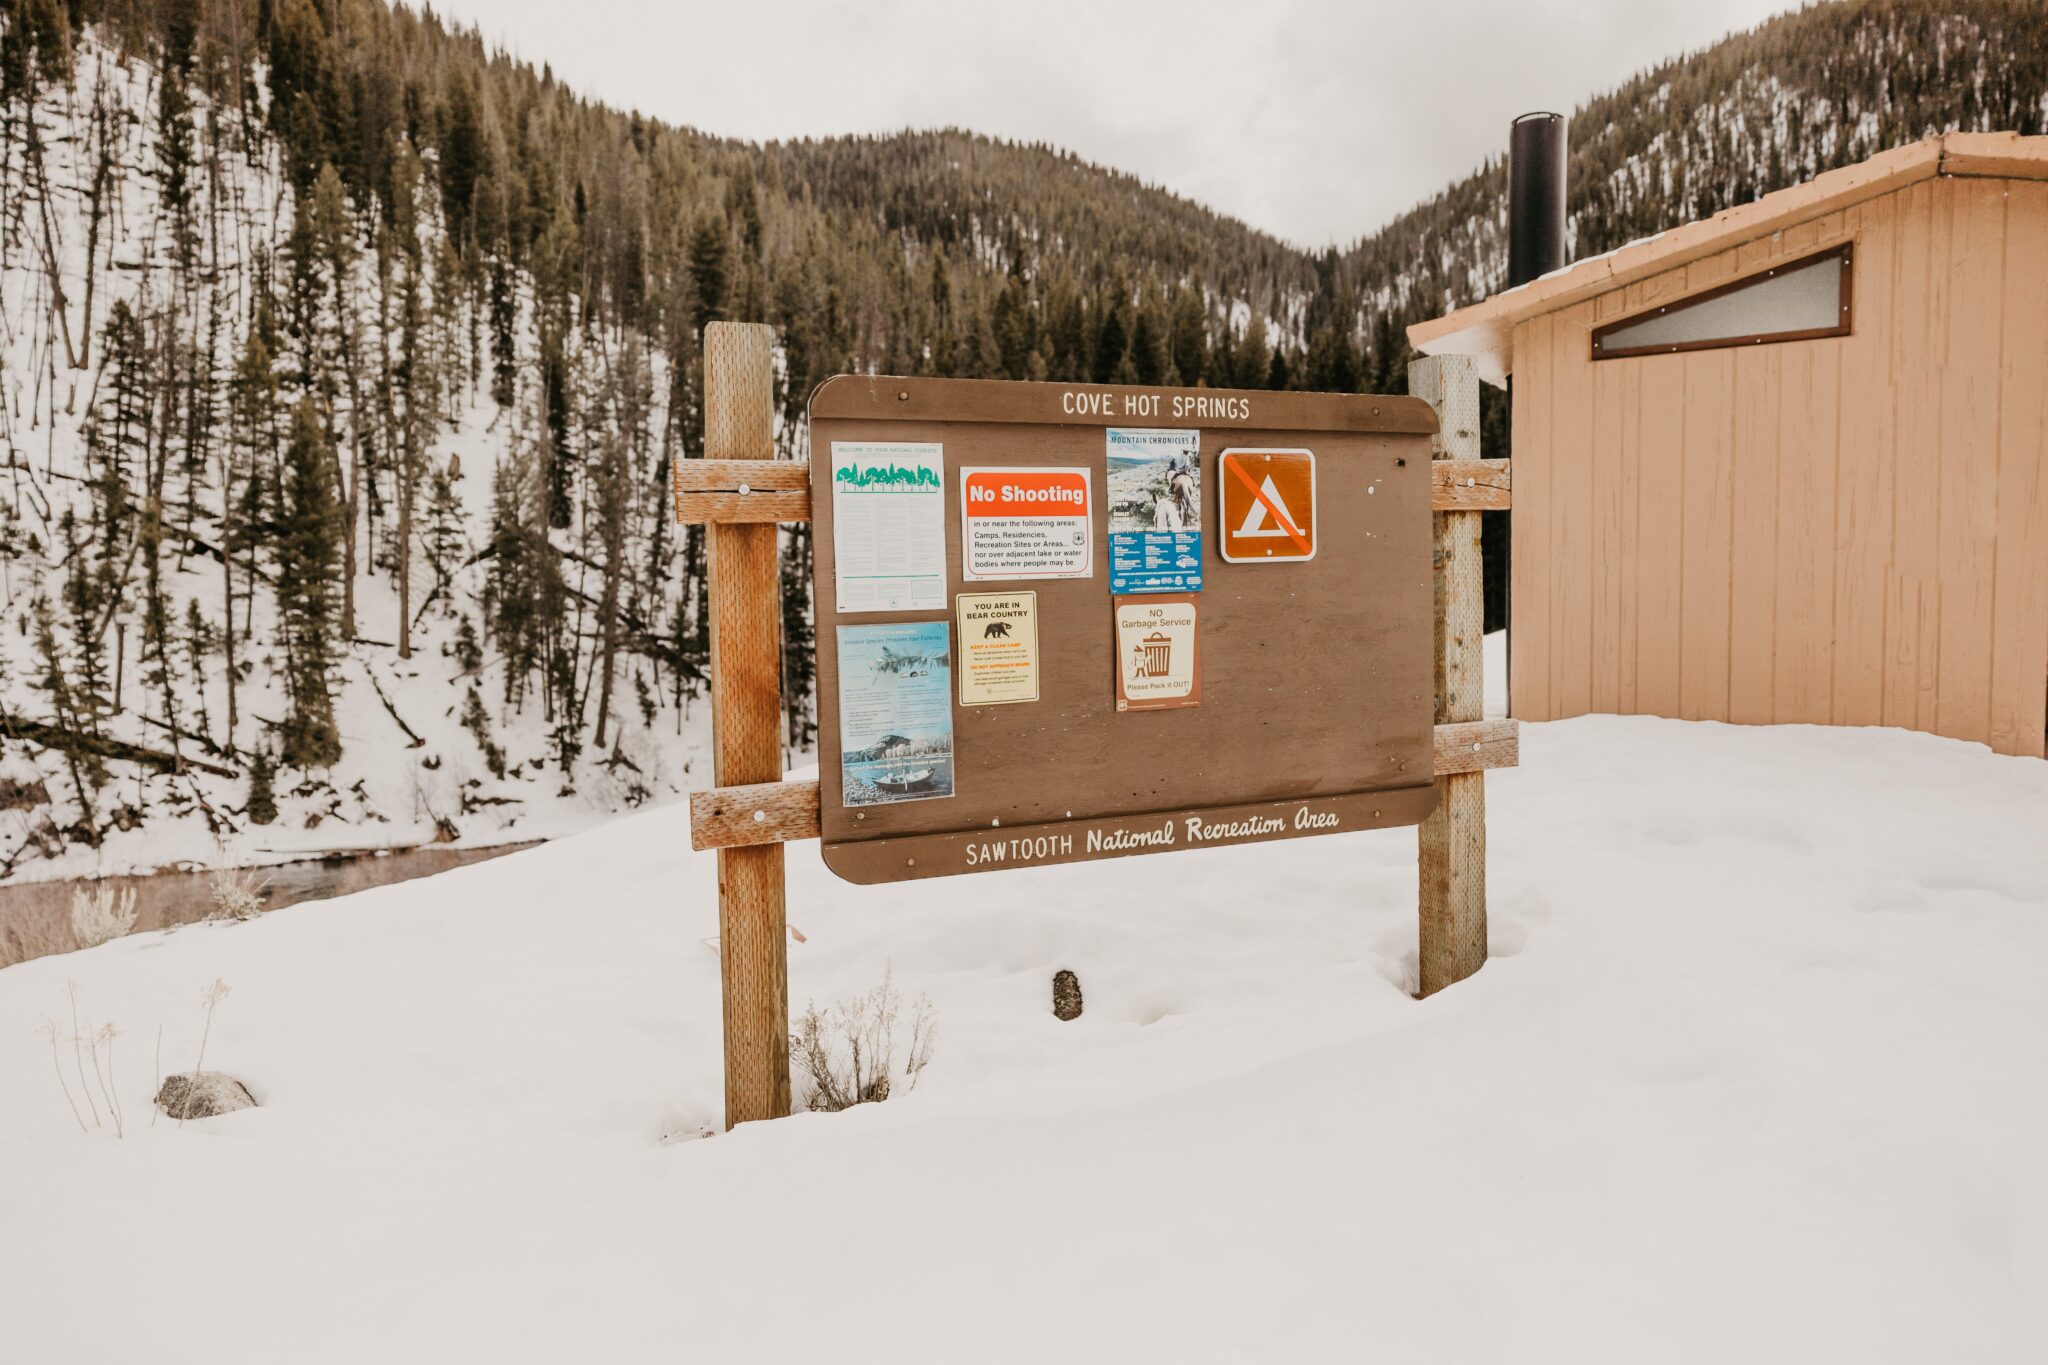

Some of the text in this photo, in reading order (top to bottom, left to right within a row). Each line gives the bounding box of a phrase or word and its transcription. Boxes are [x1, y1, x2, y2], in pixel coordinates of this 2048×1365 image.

[1063, 392, 1250, 419] COVE HOT SPRINGS
[1111, 436, 1190, 445] MOUNTAIN CHRONICLES
[970, 485, 1084, 505] No Shooting
[1022, 520, 1054, 528] following
[974, 541, 1013, 549] Recreation
[1149, 609, 1163, 617] NO
[1121, 618, 1192, 629] Garbage Service
[1127, 682, 1148, 690] Please
[1150, 681, 1165, 689] Pack
[966, 806, 1340, 866] SAWTOOTH National Recreation Area
